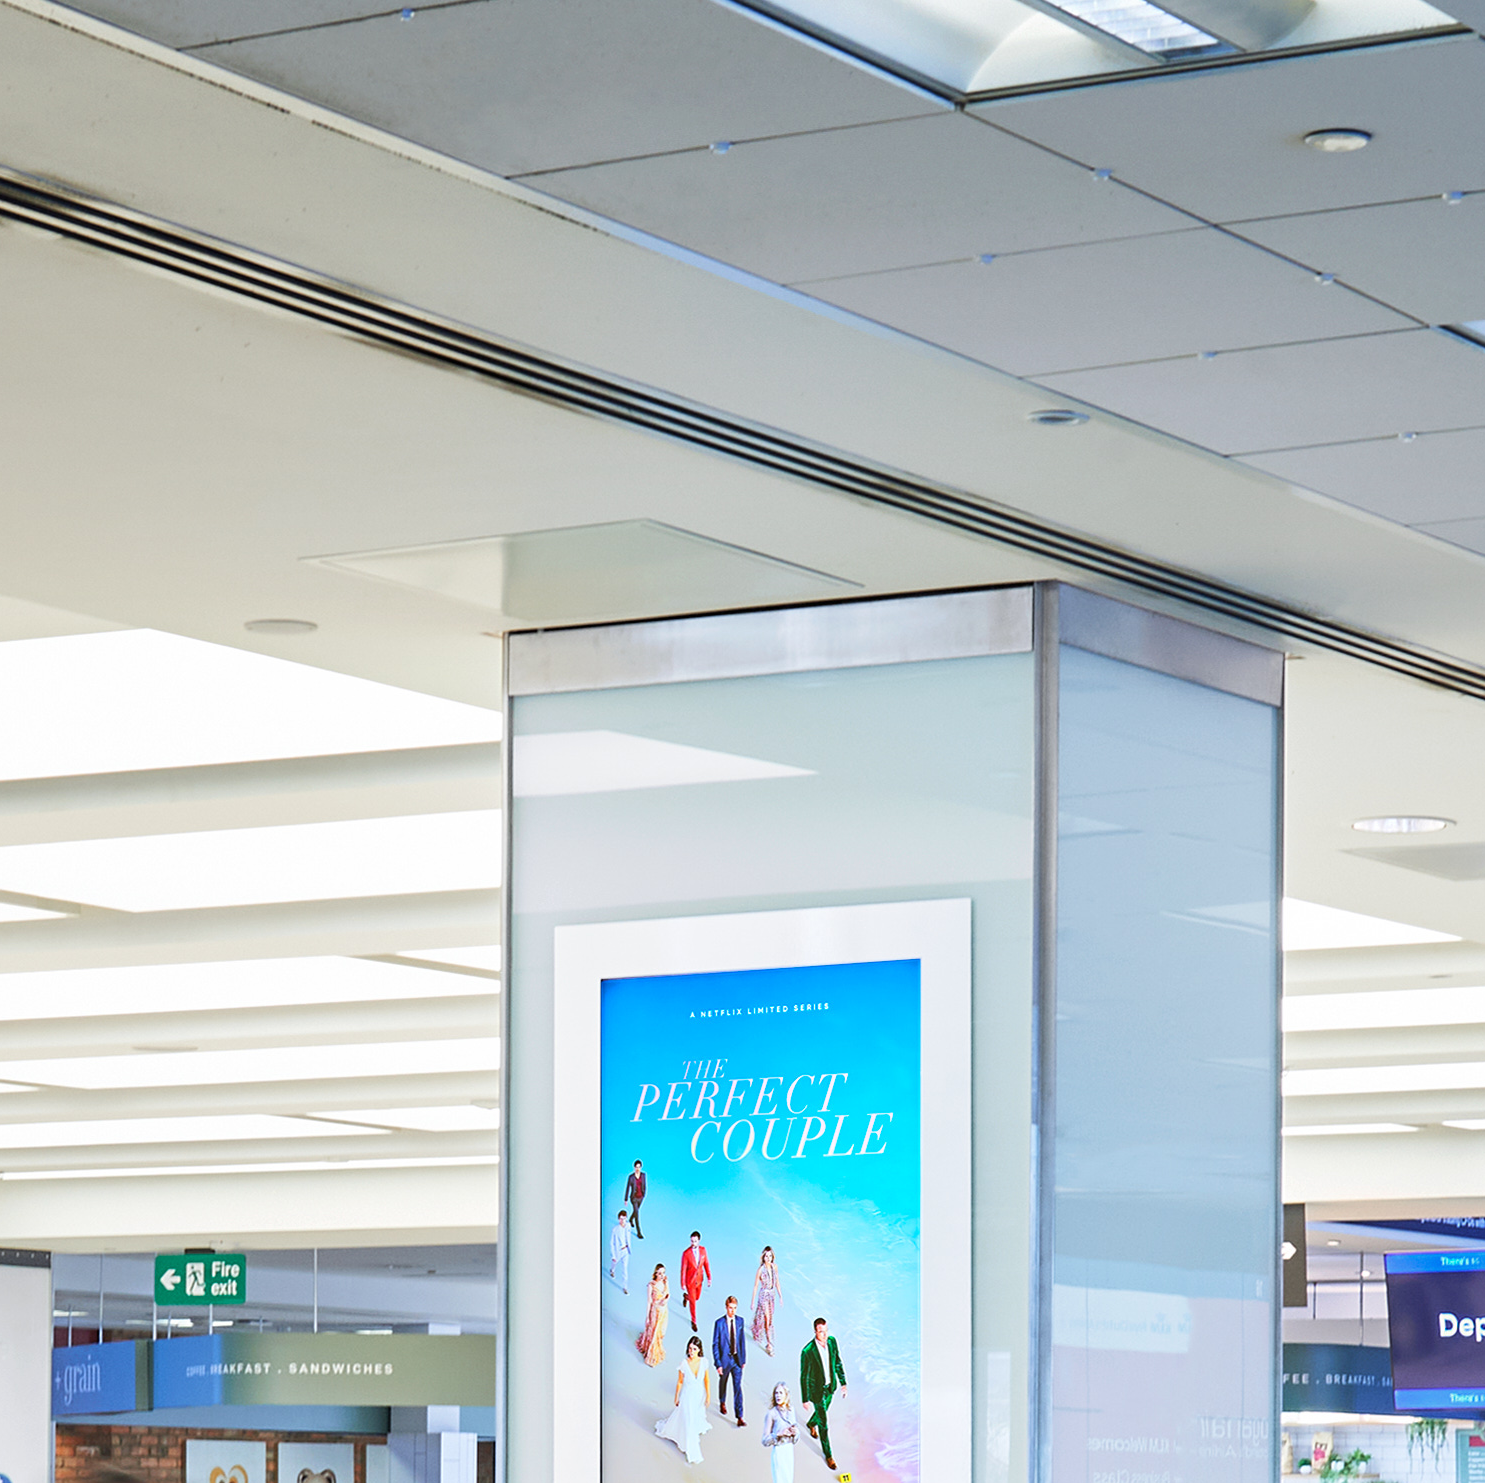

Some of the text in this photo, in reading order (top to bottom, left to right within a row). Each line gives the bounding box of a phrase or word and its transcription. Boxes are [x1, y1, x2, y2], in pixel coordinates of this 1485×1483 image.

[689, 1002, 830, 1018] A NETFLIX LIMITED SERIES
[682, 1058, 728, 1080] THE
[629, 1072, 849, 1123] PERFECT
[690, 1112, 894, 1164] COUPLE
[211, 1261, 240, 1278] Fire
[211, 1280, 238, 1297] exit
[288, 1362, 394, 1376] SANDWICHES
[64, 1355, 102, 1404] grain
[1325, 1373, 1375, 1386] BREAKFAST
